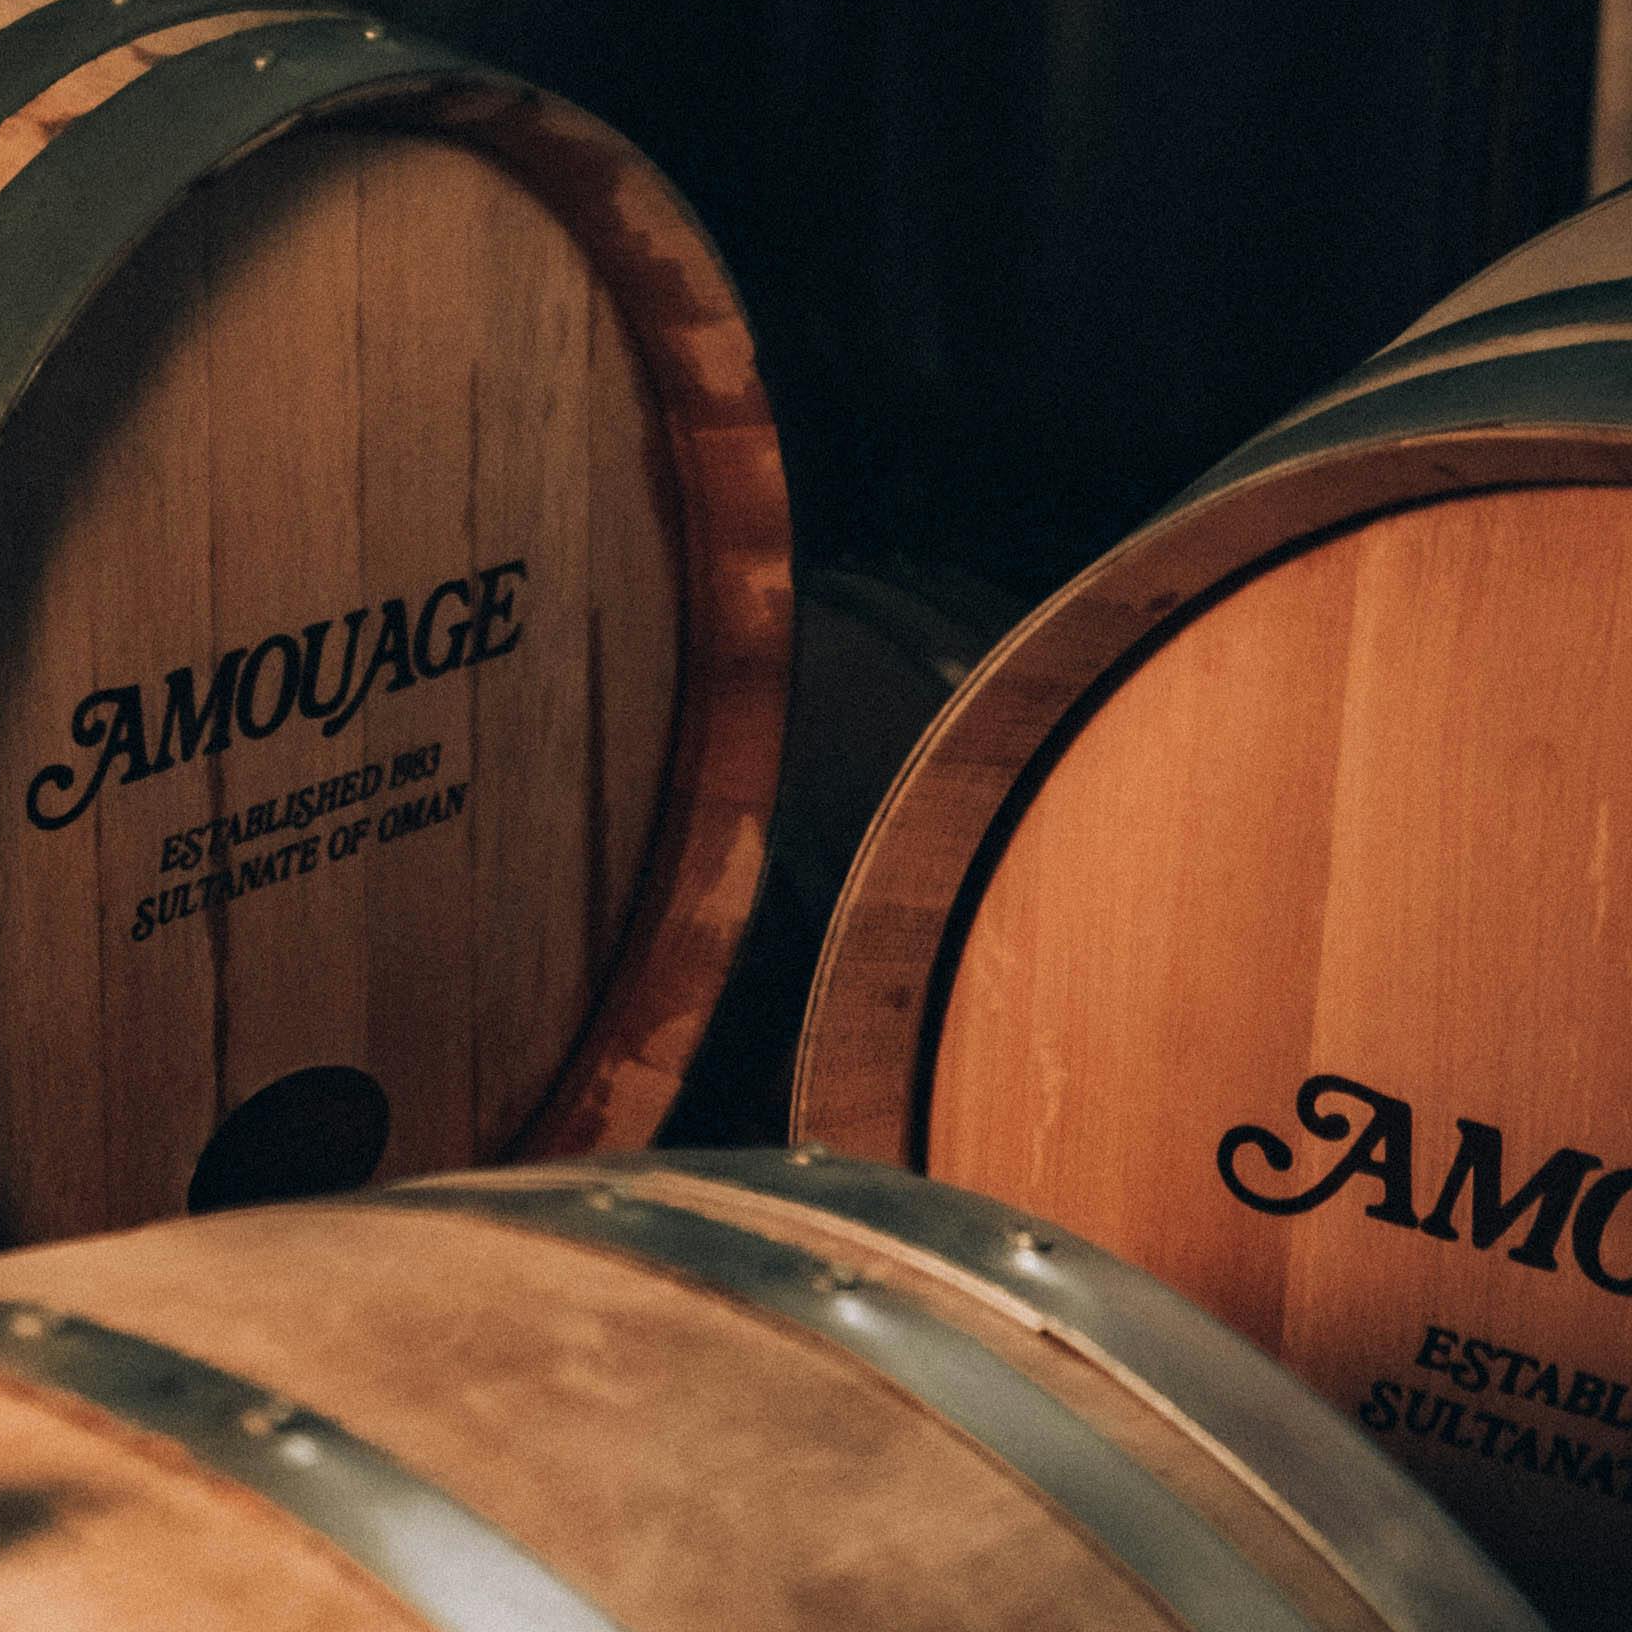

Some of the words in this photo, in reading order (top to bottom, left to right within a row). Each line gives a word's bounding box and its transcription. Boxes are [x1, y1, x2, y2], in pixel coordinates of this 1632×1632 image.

[26, 560, 527, 830] AMOUAGE
[131, 835, 321, 943] SULTANATE
[327, 818, 371, 861] OF
[377, 782, 469, 842] OMAN
[159, 763, 383, 873] ESTABLISHED
[389, 742, 441, 790] 1983
